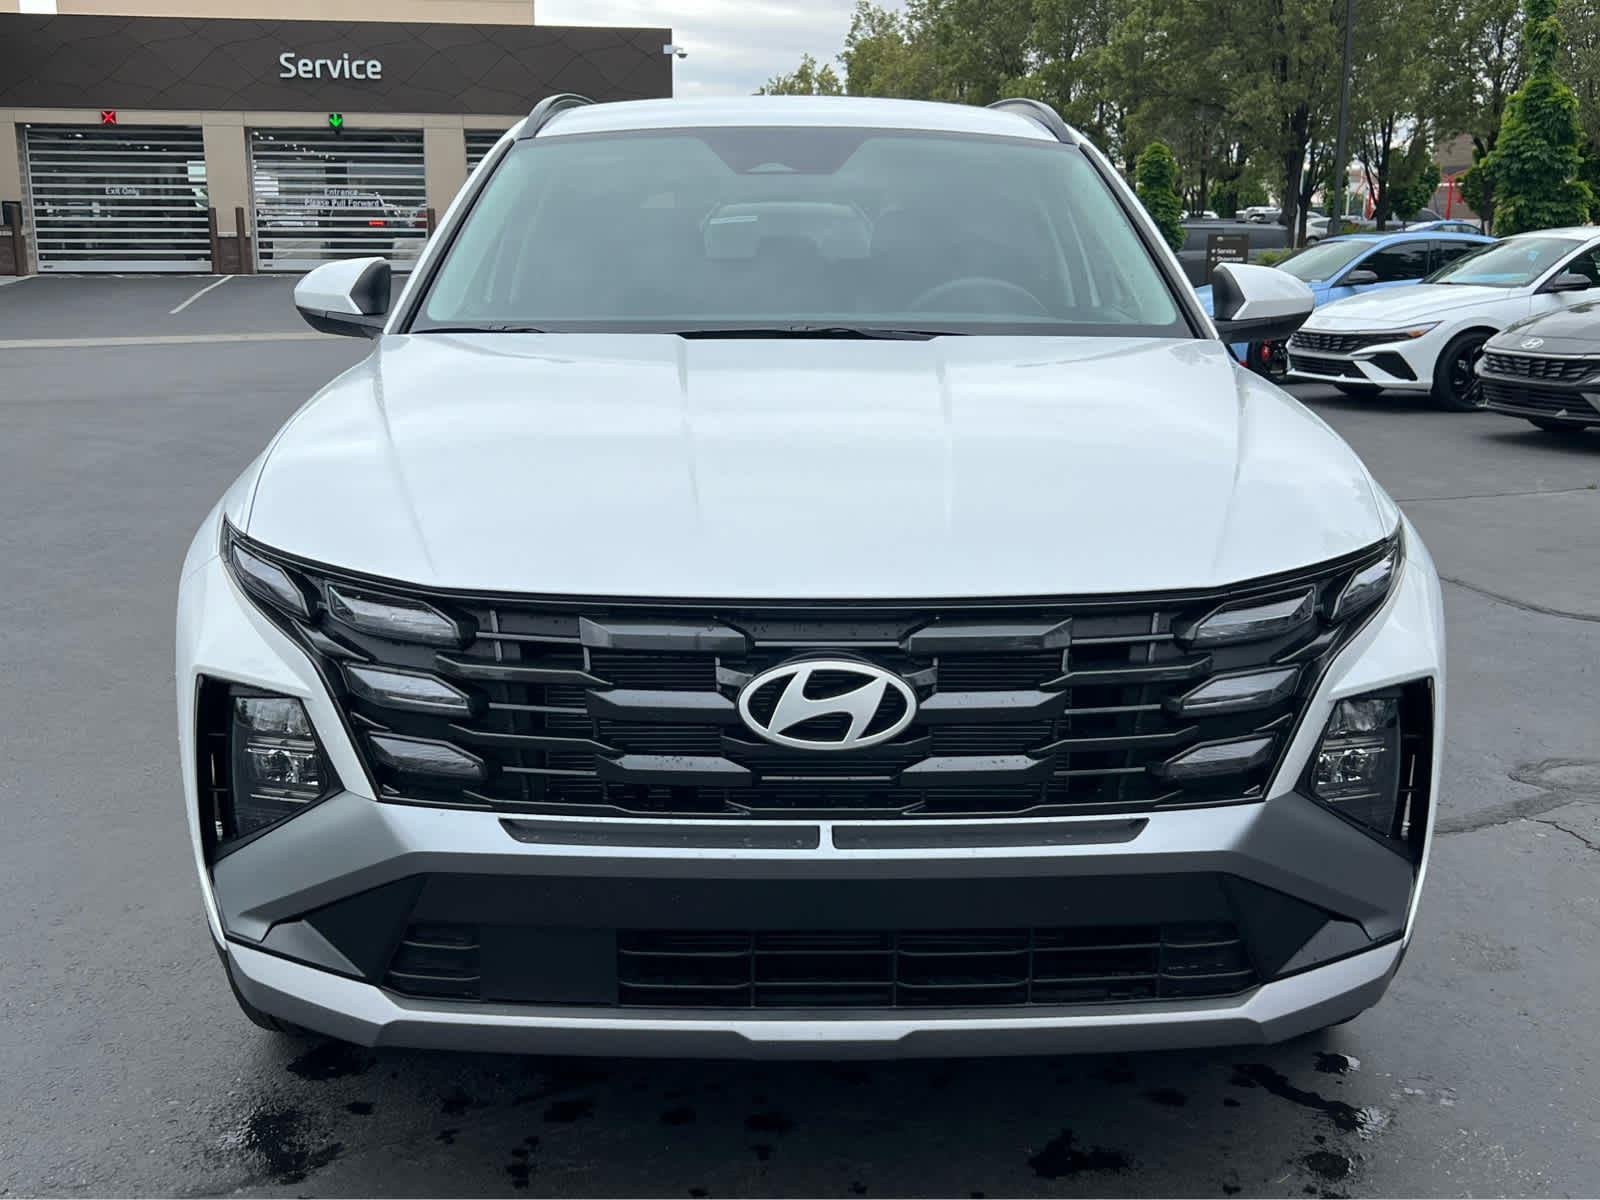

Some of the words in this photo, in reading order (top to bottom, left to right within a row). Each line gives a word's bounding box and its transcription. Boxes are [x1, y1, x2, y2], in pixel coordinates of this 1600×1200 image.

[279, 52, 382, 79] Service
[105, 185, 121, 195] Exit
[122, 185, 141, 197] Only
[323, 187, 358, 197] Entrance
[304, 198, 330, 208] Please
[331, 198, 347, 208] Pull
[348, 198, 381, 208] Forward
